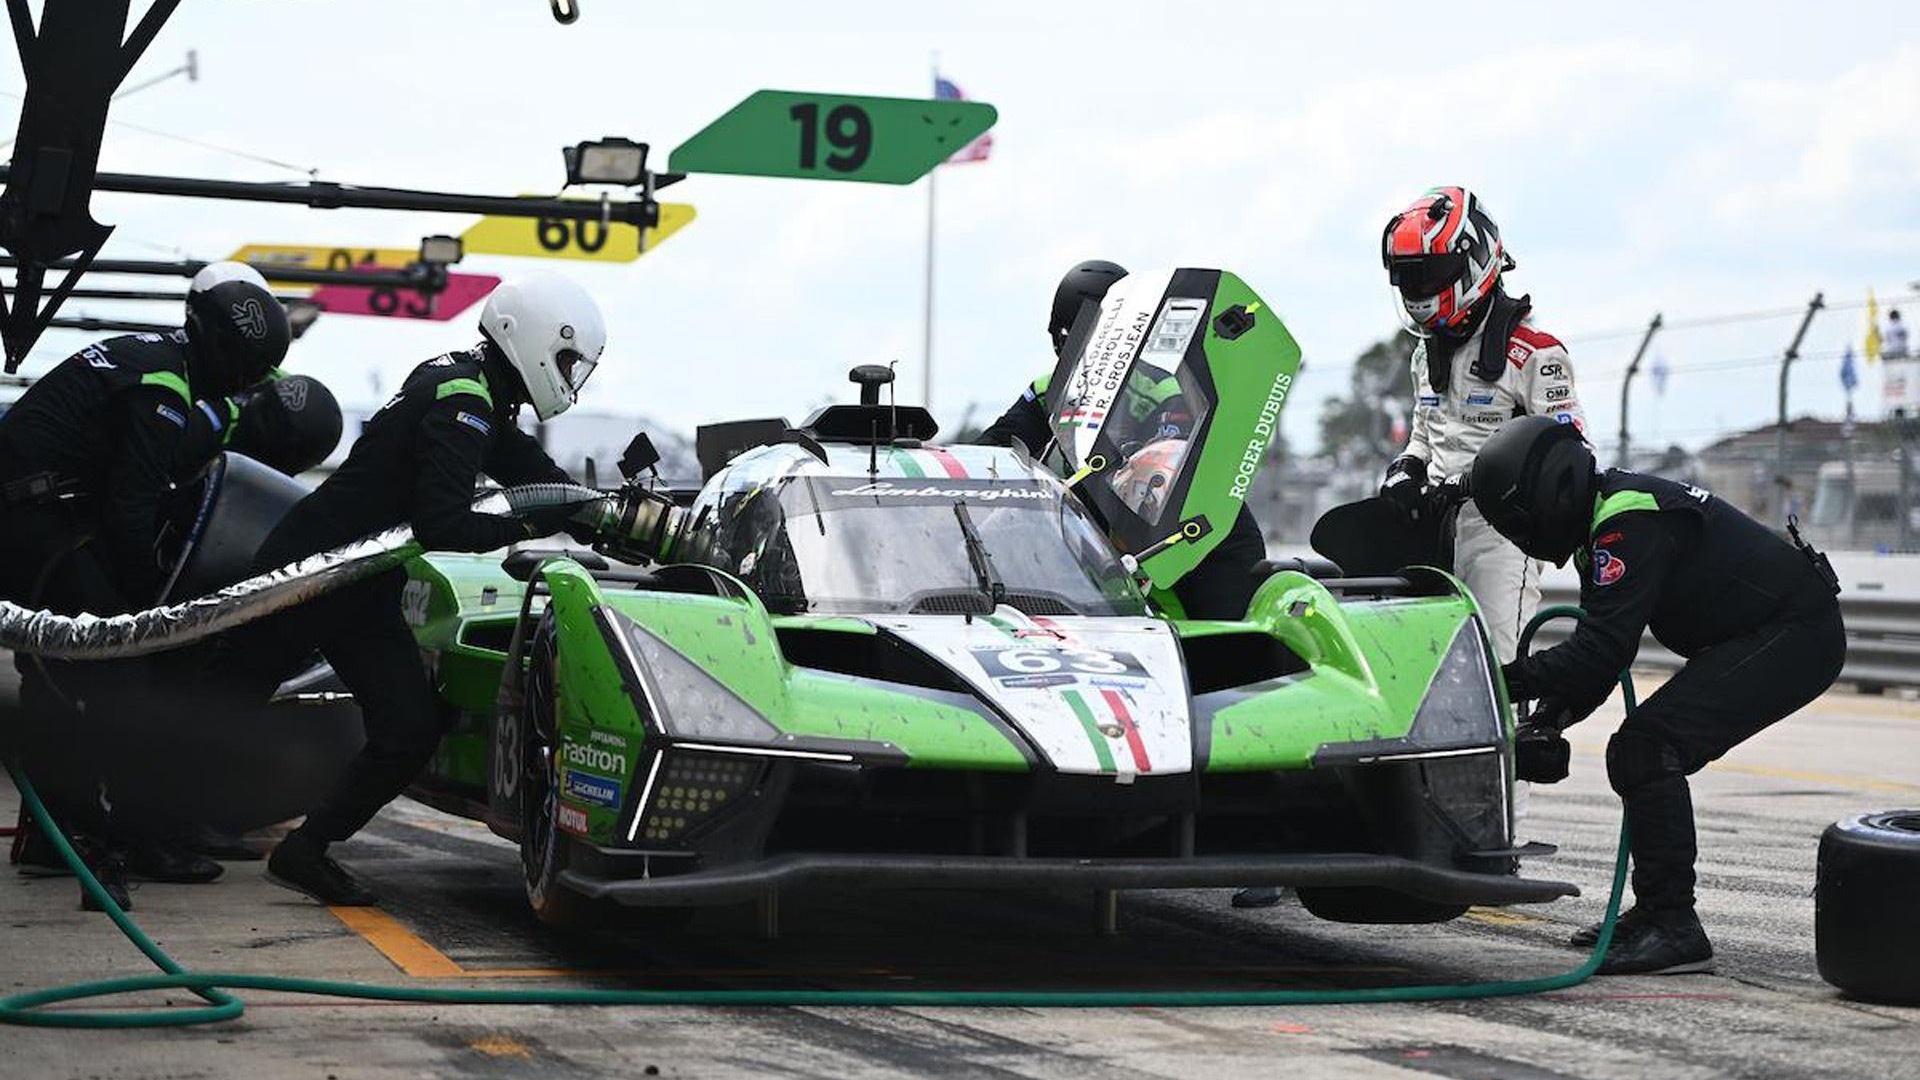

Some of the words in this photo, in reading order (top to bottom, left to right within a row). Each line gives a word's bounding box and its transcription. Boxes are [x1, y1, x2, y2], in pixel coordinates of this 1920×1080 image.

[789, 103, 873, 172] 19
[537, 217, 608, 252] 60
[1089, 327, 1124, 387] CAIROLI
[1104, 311, 1150, 391] GROSJEAN
[1540, 364, 1563, 376] CSR
[1229, 439, 1265, 500] ROGER
[1254, 373, 1291, 437] DUBUIS
[831, 482, 1055, 501] Lamborghini
[997, 649, 1128, 674] 63
